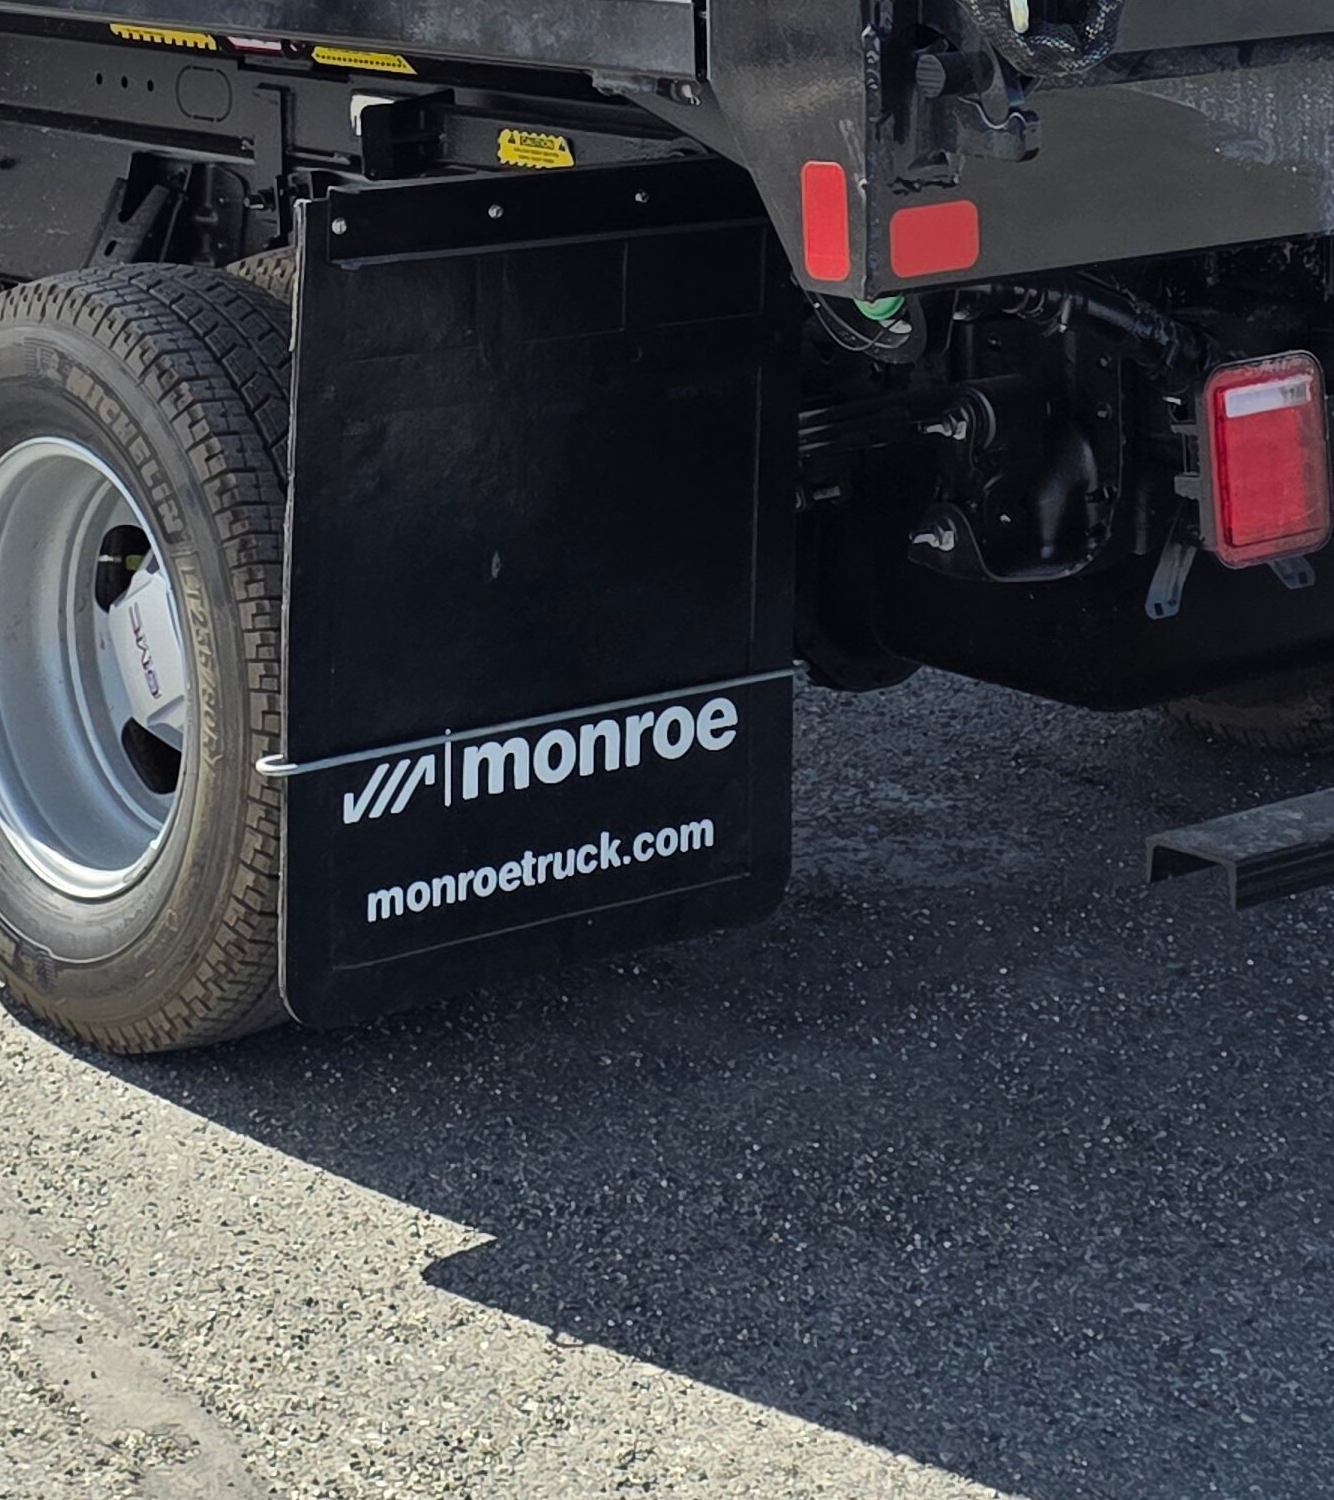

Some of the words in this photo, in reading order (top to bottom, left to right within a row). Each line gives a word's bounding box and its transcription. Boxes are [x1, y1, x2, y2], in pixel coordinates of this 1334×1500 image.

[68, 366, 184, 534] MICHELIN
[462, 698, 738, 800] monroe
[367, 818, 714, 923] monroetruck.com
